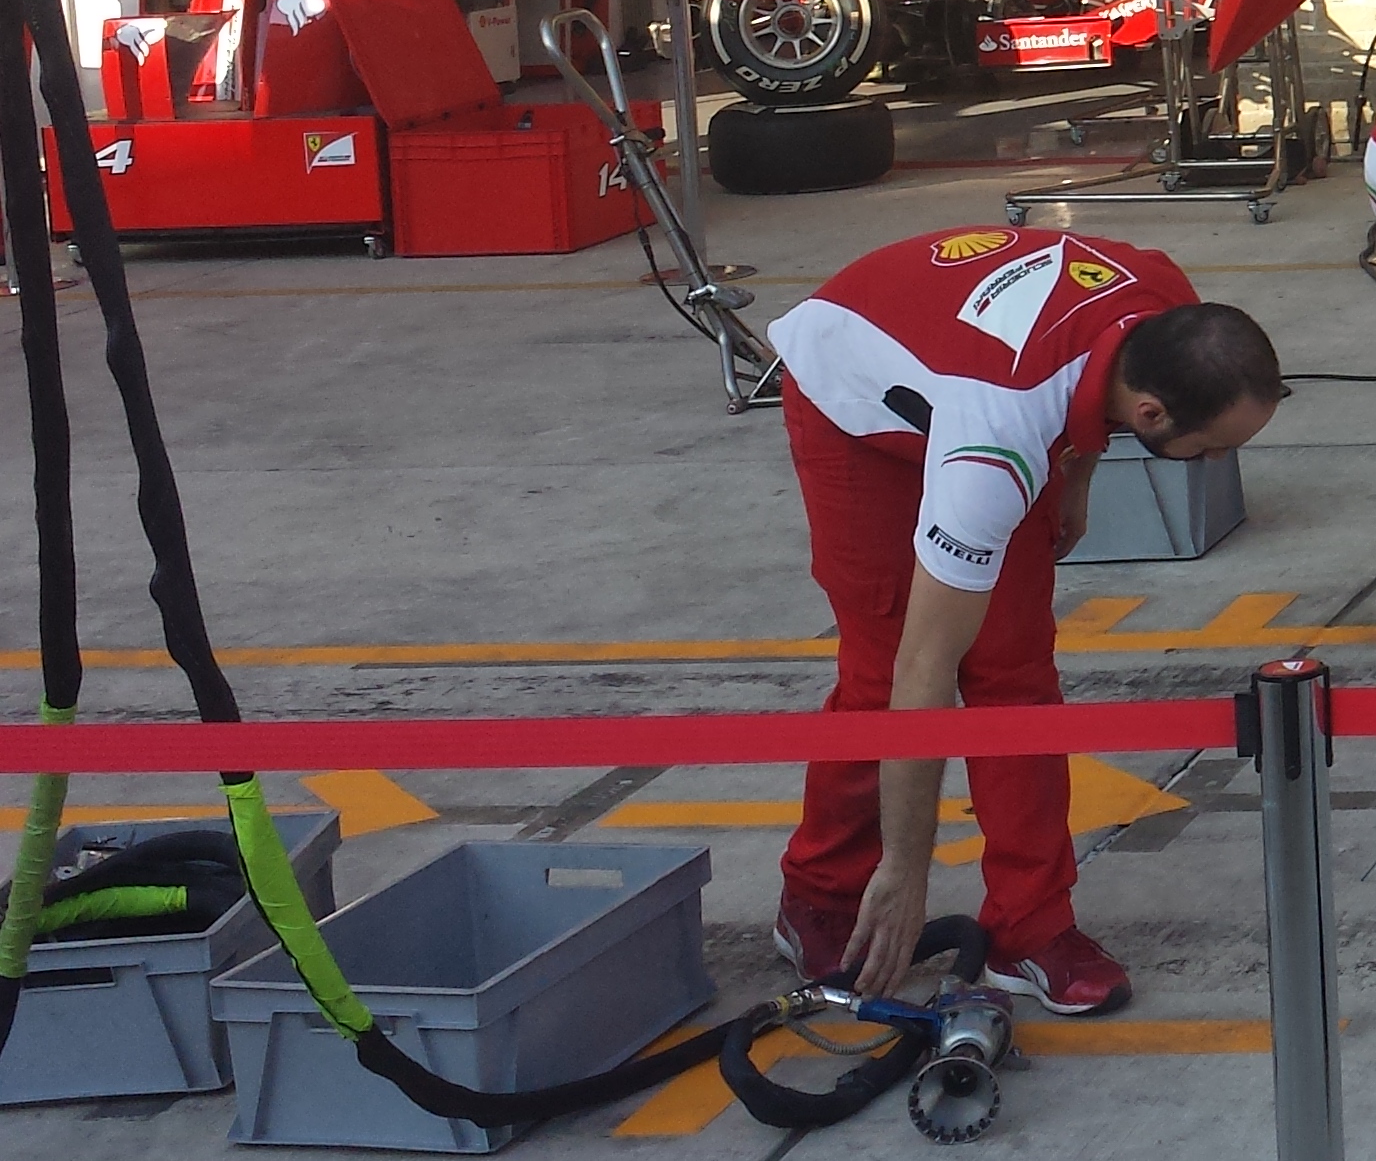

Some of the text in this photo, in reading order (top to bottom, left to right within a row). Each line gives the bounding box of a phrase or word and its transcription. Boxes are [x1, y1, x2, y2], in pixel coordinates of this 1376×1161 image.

[999, 28, 1088, 52] Santander
[735, 65, 824, 94] ZERO
[94, 138, 134, 175] 4
[972, 264, 1024, 311] FERRARI
[990, 259, 1054, 300] SCUDERIA
[926, 523, 994, 566] PIRELLI
